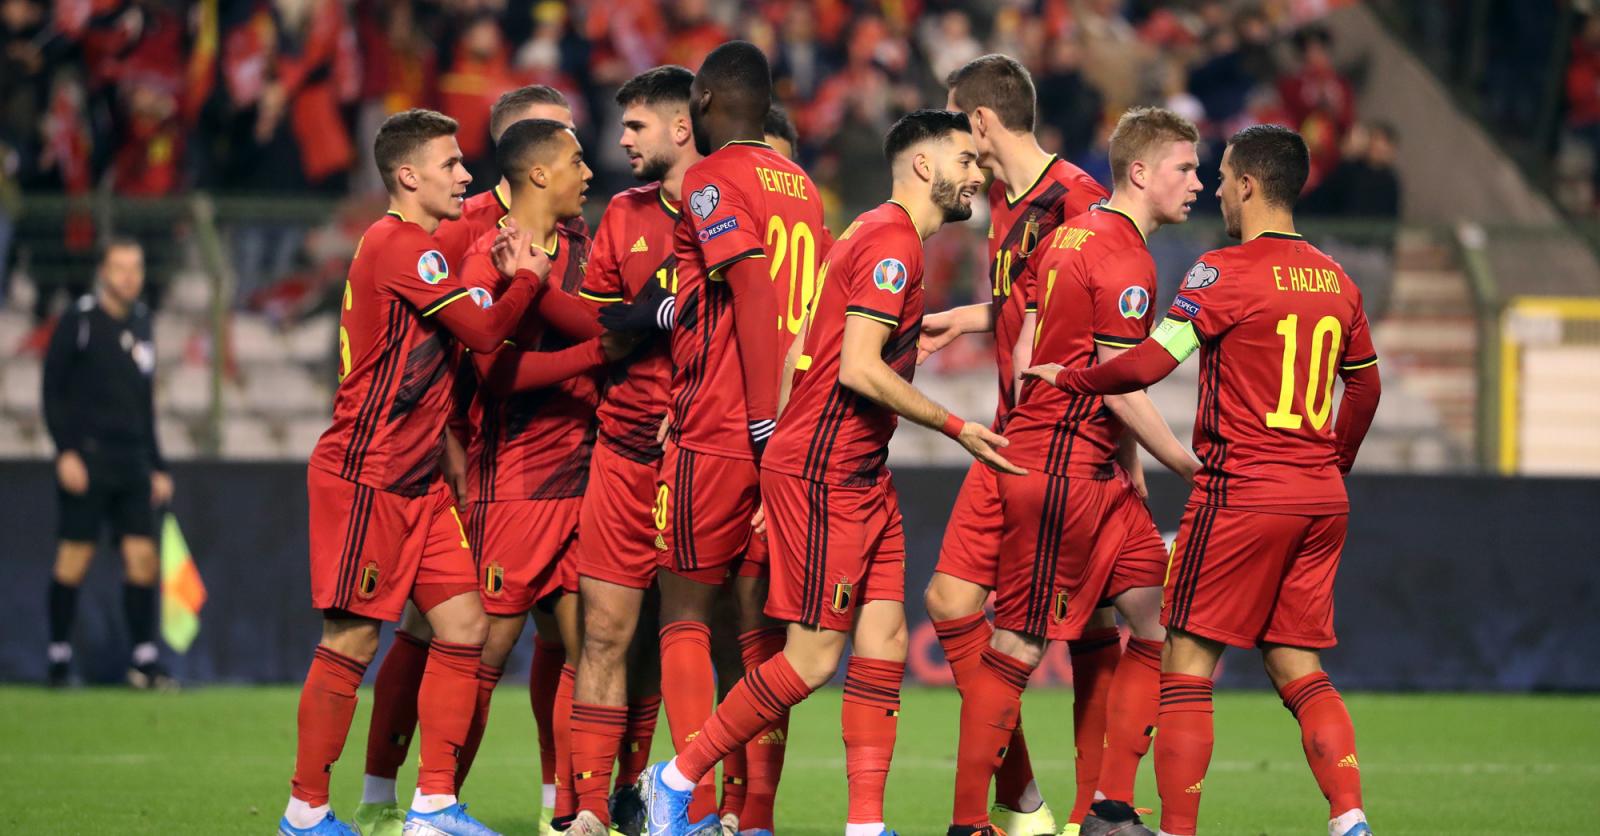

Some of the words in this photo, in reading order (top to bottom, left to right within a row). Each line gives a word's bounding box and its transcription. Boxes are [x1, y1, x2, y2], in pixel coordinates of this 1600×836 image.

[709, 219, 736, 236] RESPECT
[767, 215, 815, 335] 20
[993, 249, 1011, 296] 18
[1273, 266, 1288, 290] E.
[1291, 267, 1340, 293] HAZARD
[1266, 314, 1341, 430] 10
